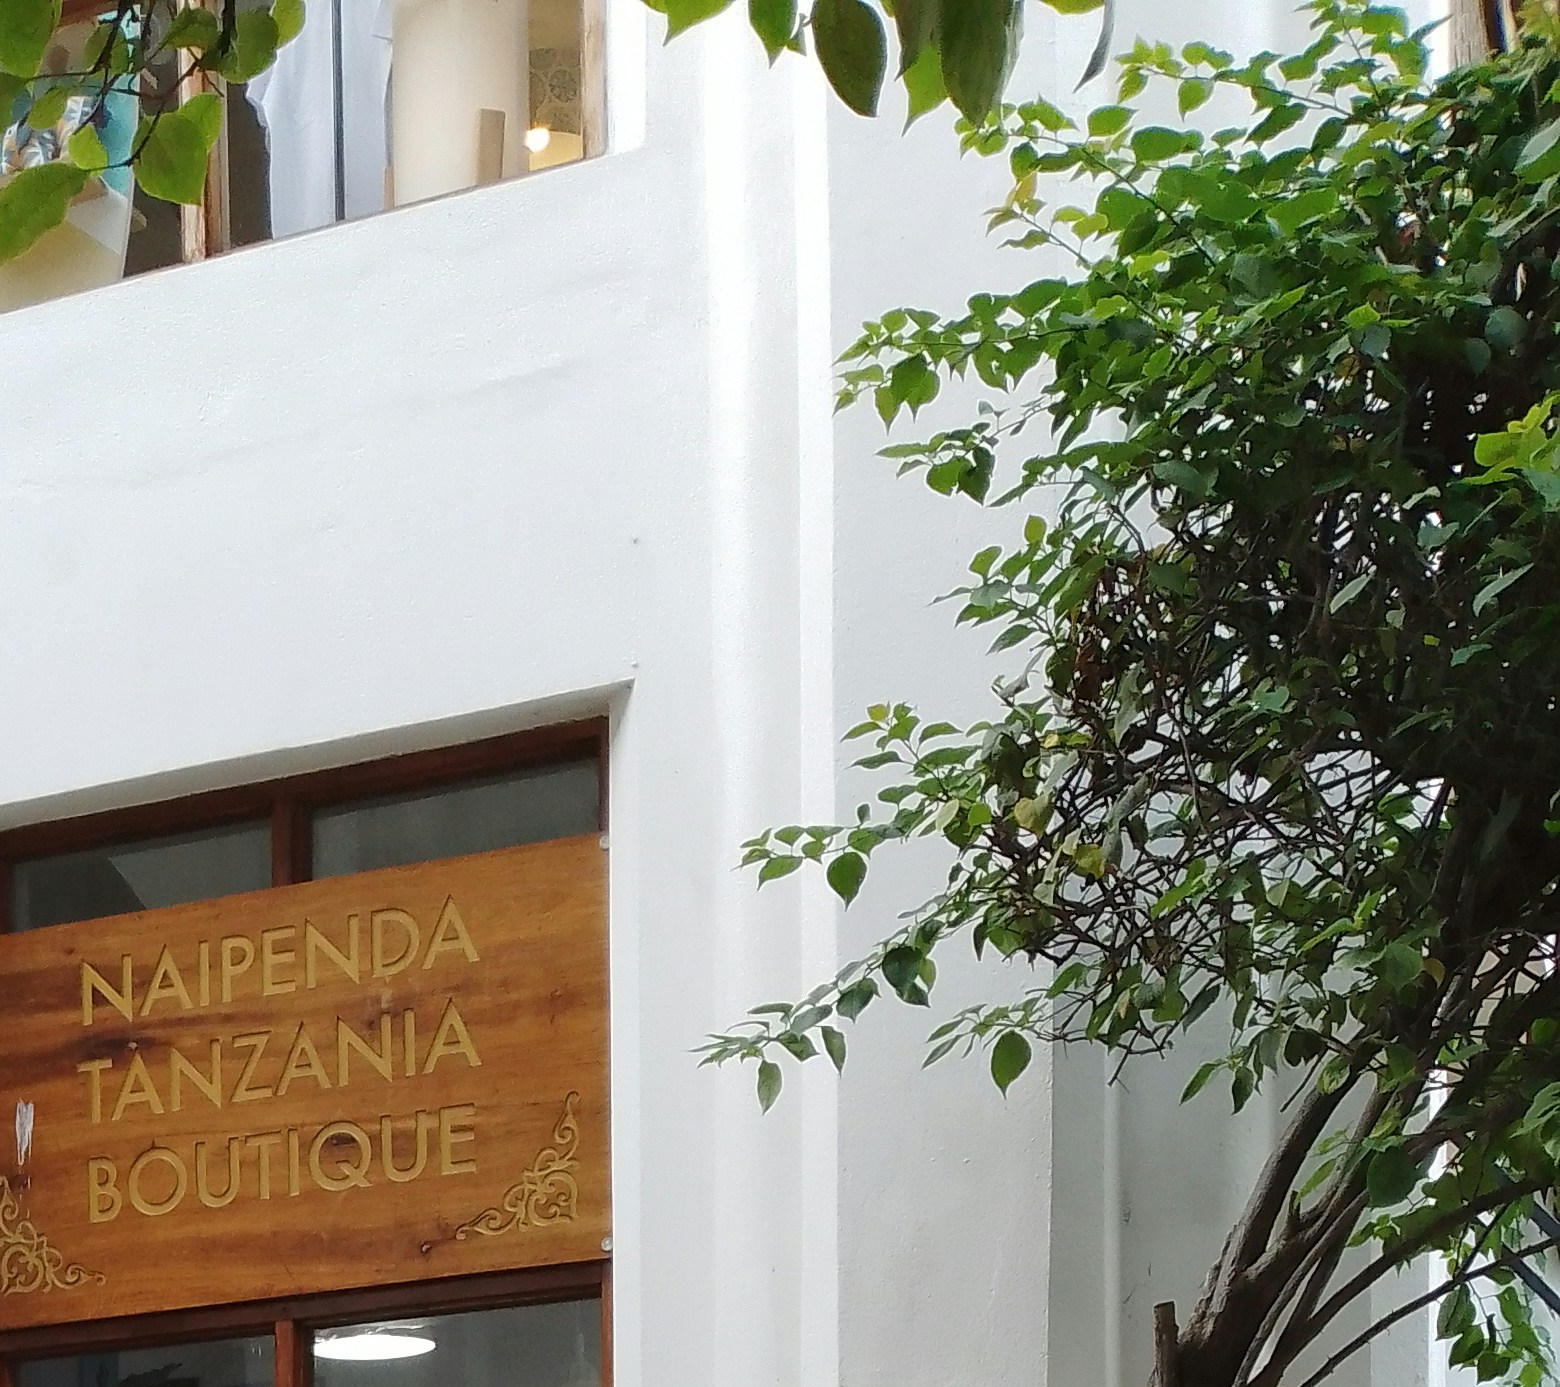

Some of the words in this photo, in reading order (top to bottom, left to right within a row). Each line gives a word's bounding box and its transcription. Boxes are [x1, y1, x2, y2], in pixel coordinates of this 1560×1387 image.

[80, 894, 480, 1025] NAIPENDA
[77, 997, 482, 1123] TANZANIA
[88, 1103, 478, 1224] BOUTIQUE
